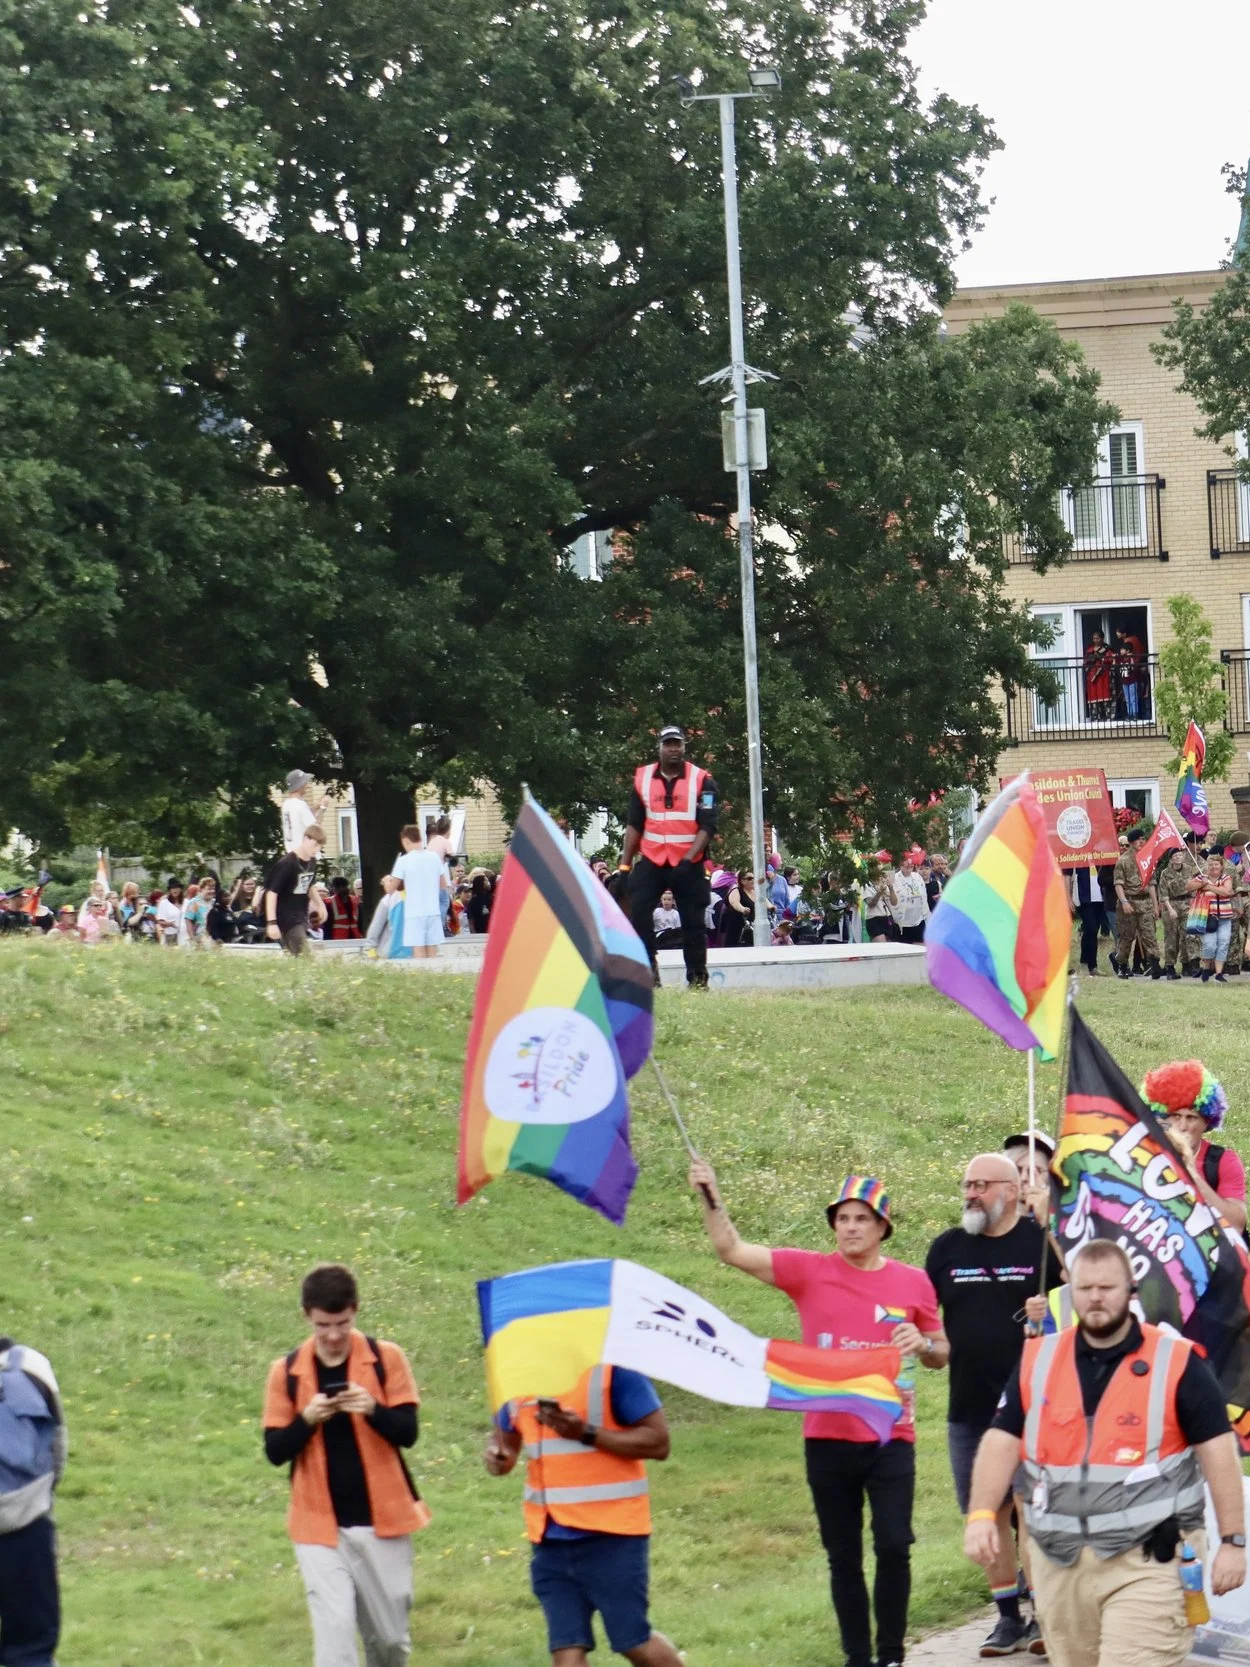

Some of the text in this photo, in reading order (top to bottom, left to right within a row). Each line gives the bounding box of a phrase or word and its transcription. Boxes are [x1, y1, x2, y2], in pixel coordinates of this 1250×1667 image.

[1031, 777, 1066, 791] sildon
[1068, 775, 1075, 786] &
[1037, 793, 1055, 804] des
[1057, 789, 1085, 802] Union
[553, 1051, 590, 1097] Pride
[1121, 1199, 1184, 1263] HAS
